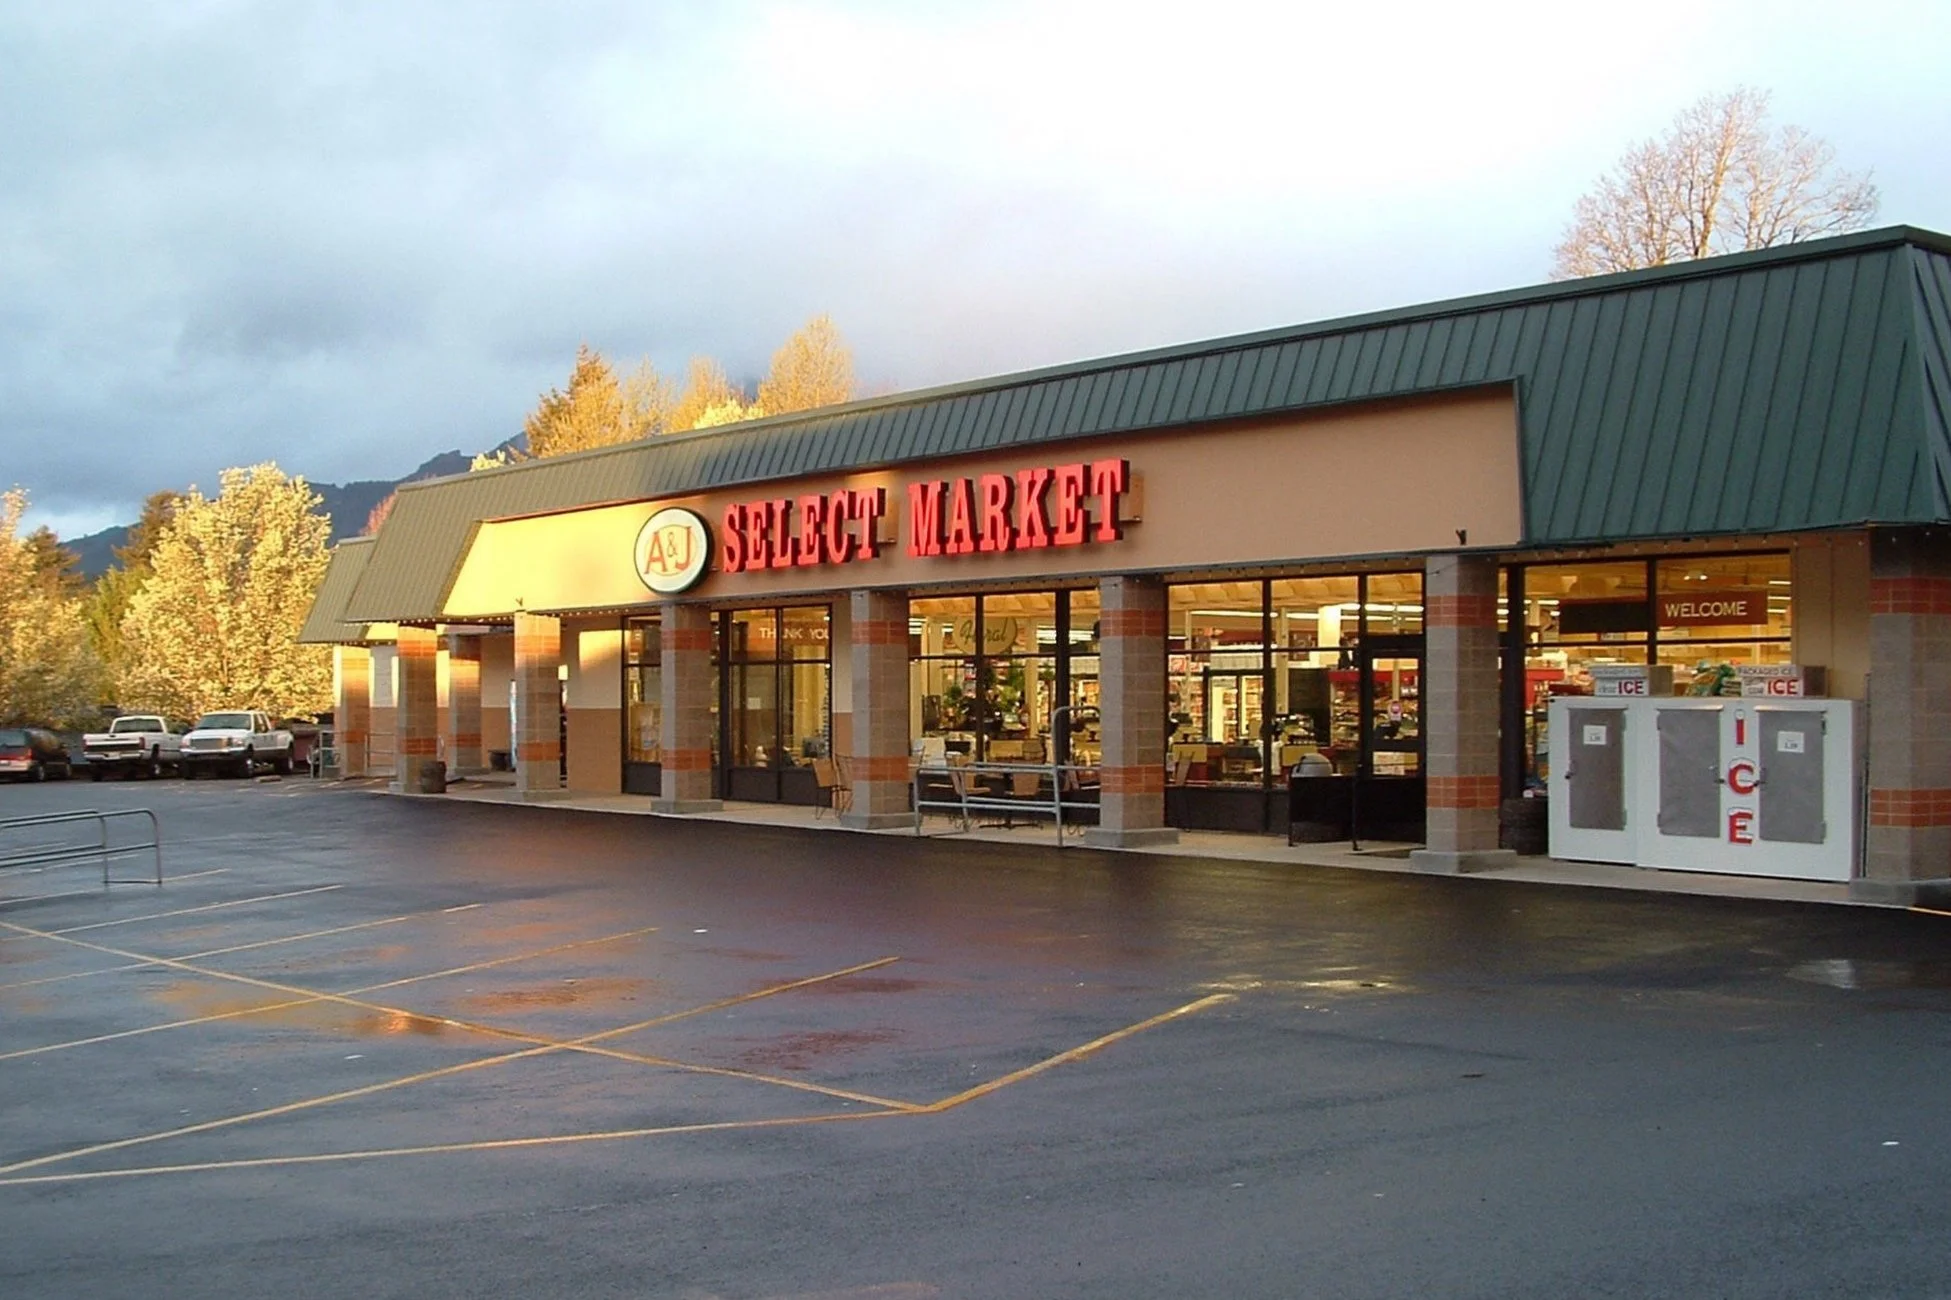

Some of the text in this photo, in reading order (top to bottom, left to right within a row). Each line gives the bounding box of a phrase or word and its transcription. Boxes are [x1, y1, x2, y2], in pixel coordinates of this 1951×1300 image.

[722, 458, 1129, 573] SELECT MARKET
[644, 525, 692, 575] A&J
[1664, 601, 1749, 618] WELCOME
[960, 616, 1006, 646] Fral
[1617, 680, 1645, 695] ICE
[1767, 679, 1800, 695] ICE
[1727, 709, 1756, 845] ICE
